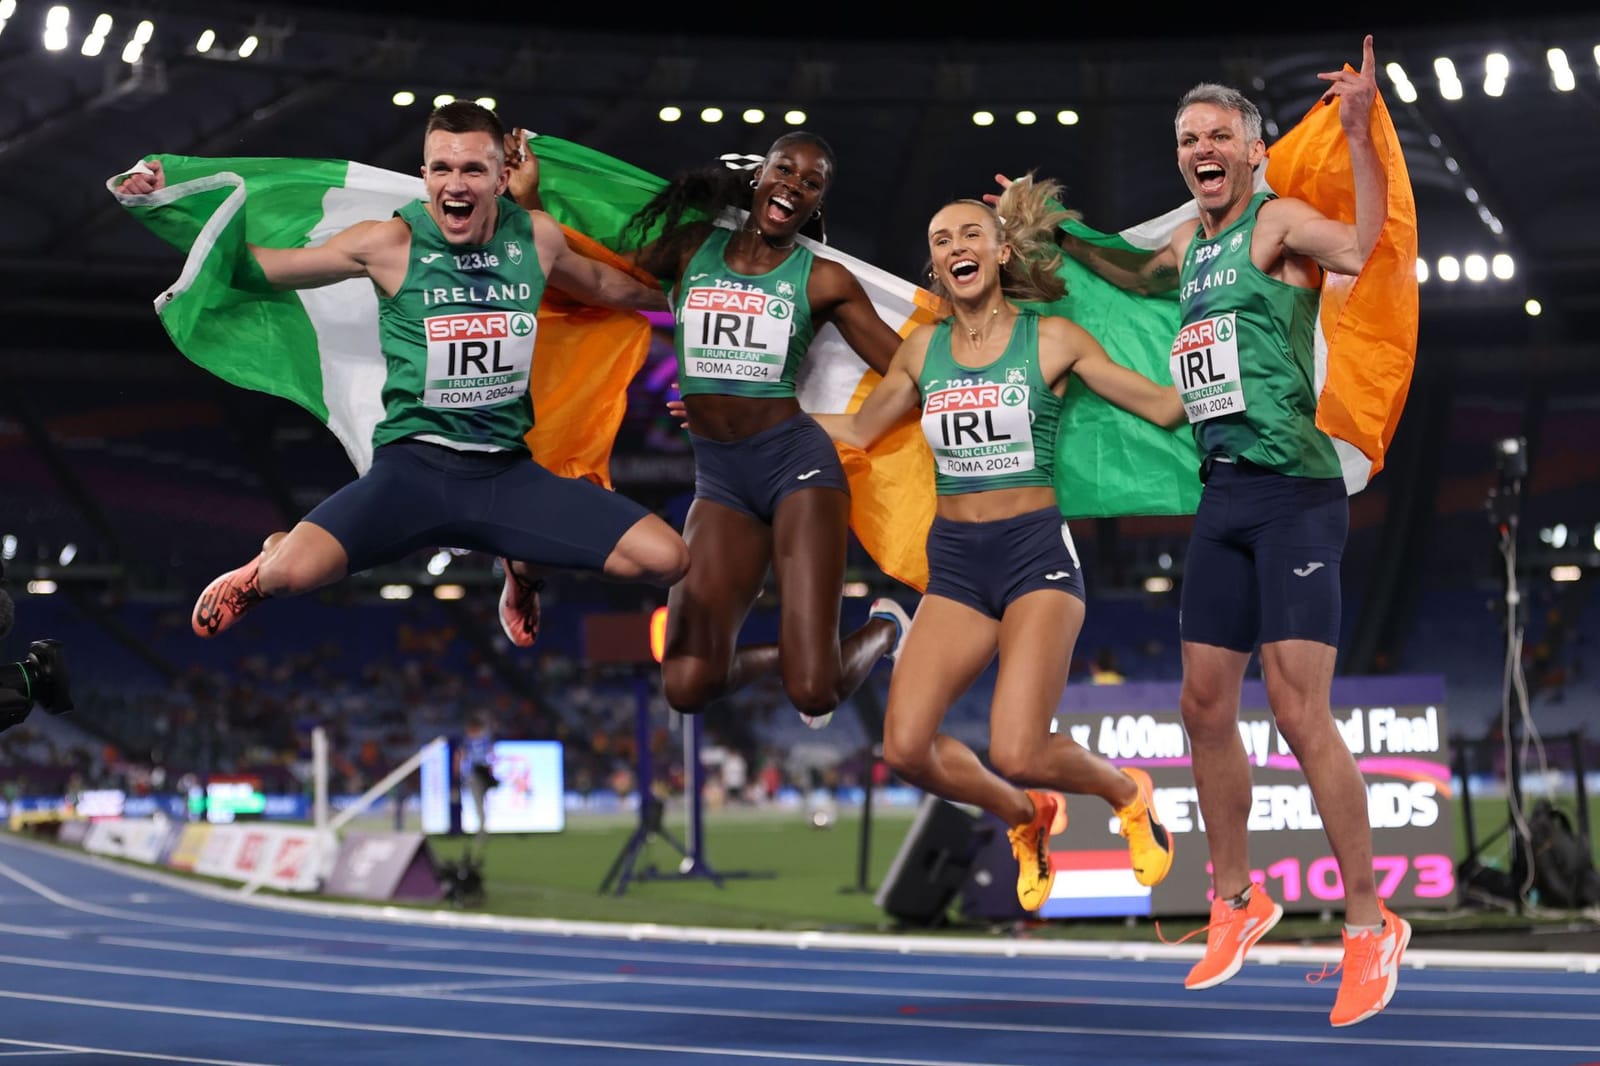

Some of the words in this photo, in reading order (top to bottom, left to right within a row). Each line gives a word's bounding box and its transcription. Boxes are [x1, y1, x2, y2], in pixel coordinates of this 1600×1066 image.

[453, 252, 500, 270] 123.ie
[423, 283, 531, 305] IRELAND
[1180, 268, 1237, 303] ELAND
[690, 292, 763, 312] SPAR
[430, 317, 506, 338] SPAR
[702, 312, 767, 350] IRL
[1172, 324, 1213, 353] SPAR
[447, 340, 514, 377] IRL
[706, 349, 727, 358] RUN
[696, 361, 733, 374] ROMA
[735, 364, 768, 378] 2024
[1180, 348, 1226, 390] IRL
[454, 378, 476, 388] RUN
[440, 391, 482, 403] ROMA
[485, 385, 514, 400] 2024
[928, 388, 998, 412] SPAR
[1189, 390, 1201, 400] RUN
[1189, 403, 1209, 417] ROMA
[1209, 396, 1234, 413] 2024
[940, 410, 1012, 447] IRL
[947, 460, 983, 472] ROMA
[986, 456, 1020, 470] 2024
[952, 449, 972, 458] RUN
[1098, 714, 1185, 759] 400m
[1368, 706, 1440, 754] Final
[1109, 781, 1439, 834] EERLDS
[1206, 854, 1455, 902] :1073
